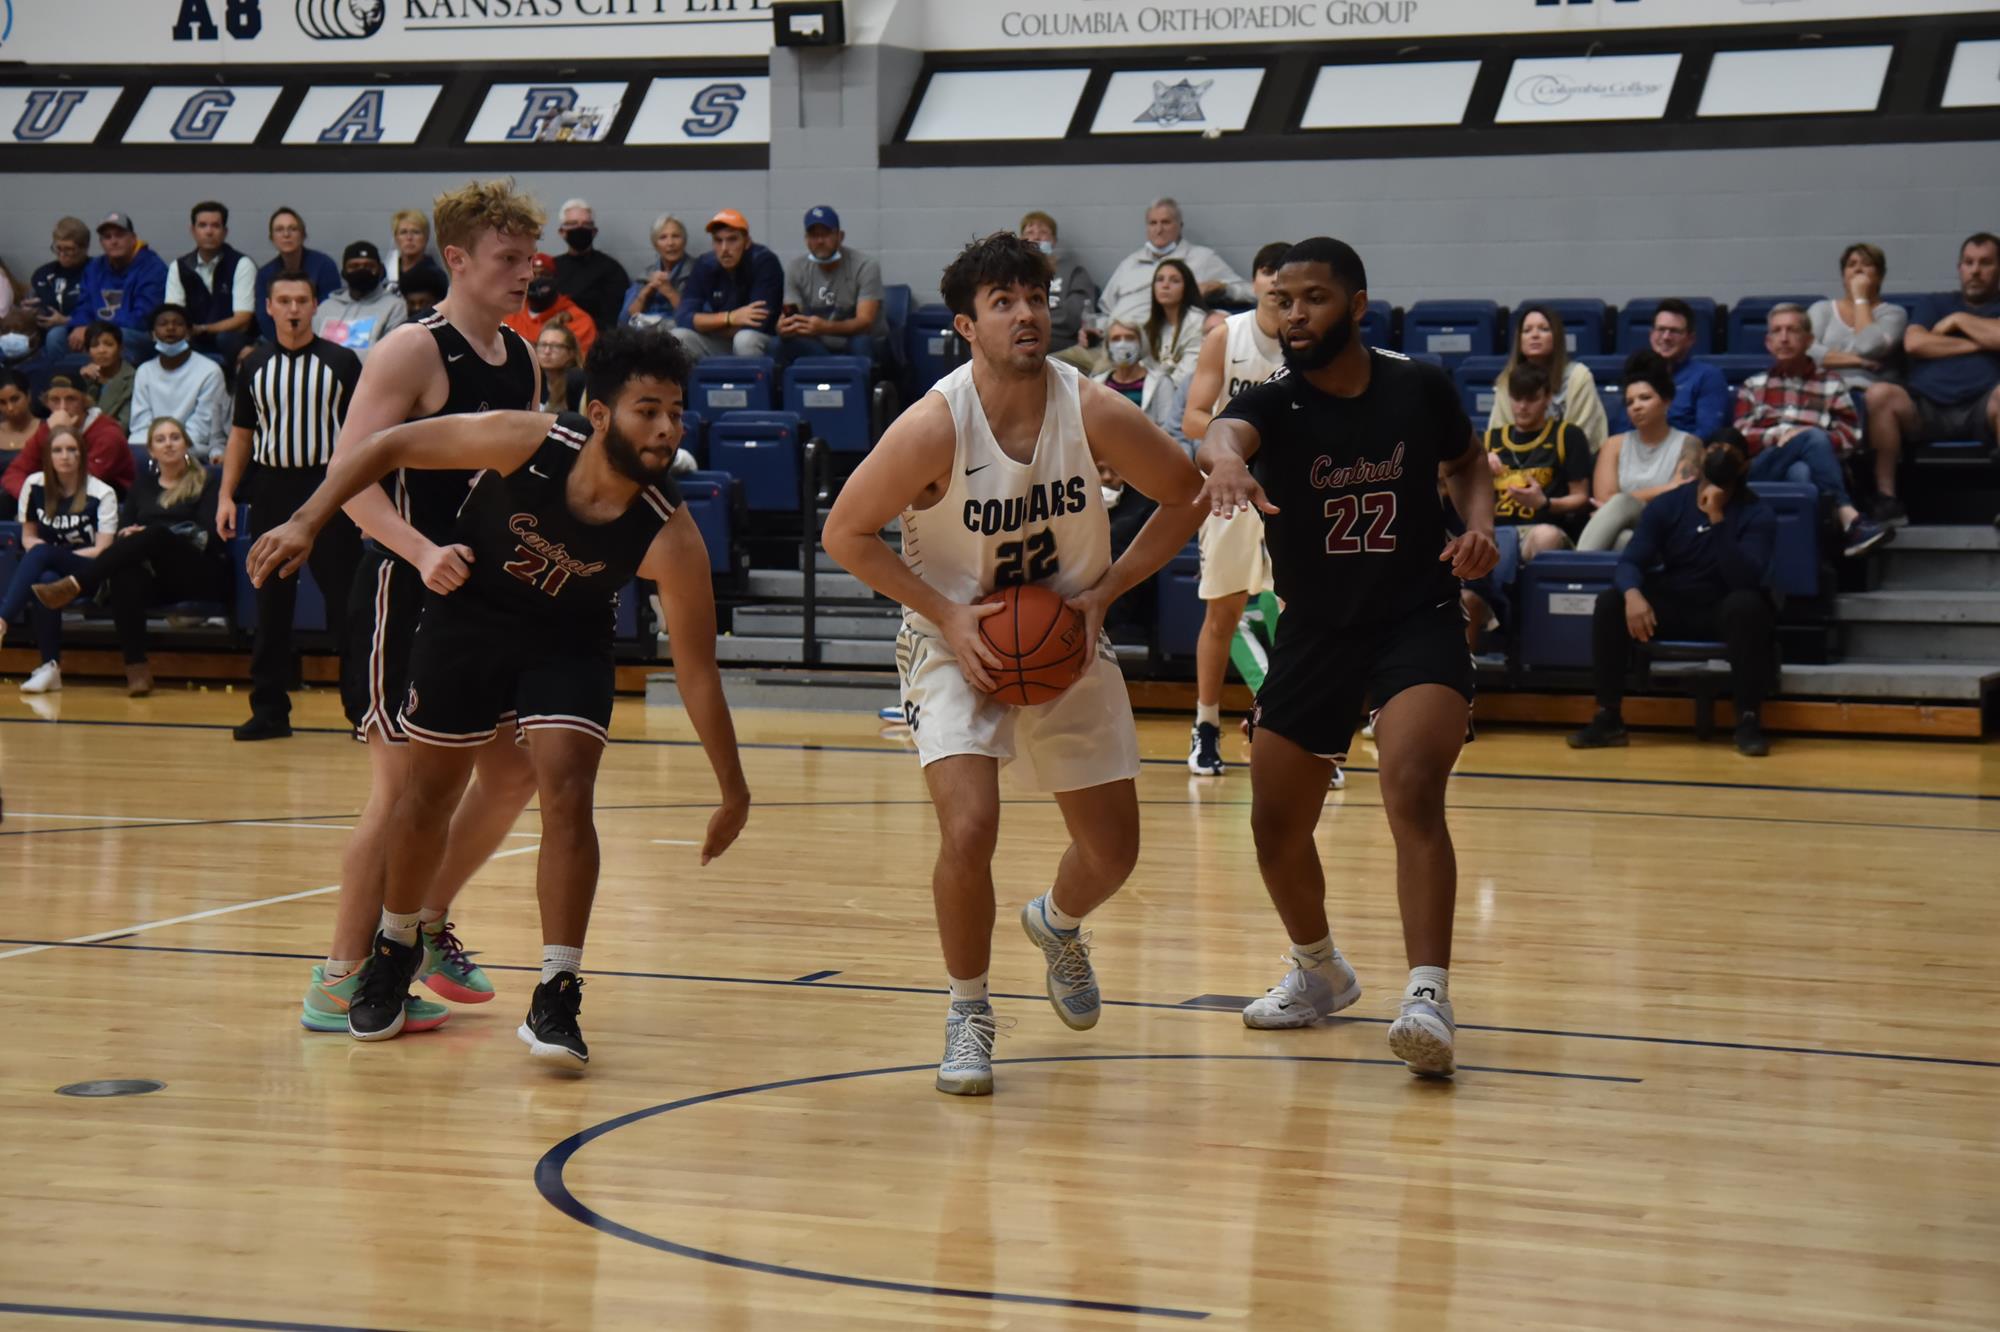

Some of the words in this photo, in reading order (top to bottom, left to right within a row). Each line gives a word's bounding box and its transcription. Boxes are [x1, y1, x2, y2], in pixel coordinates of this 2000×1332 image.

[12, 90, 88, 141] U
[169, 89, 237, 141] G
[319, 89, 385, 142] A
[682, 83, 747, 138] S
[1311, 441, 1405, 489] Central
[509, 513, 606, 577] Central
[1324, 491, 1397, 554] 22
[503, 545, 571, 597] 21
[995, 526, 1061, 588] 22
